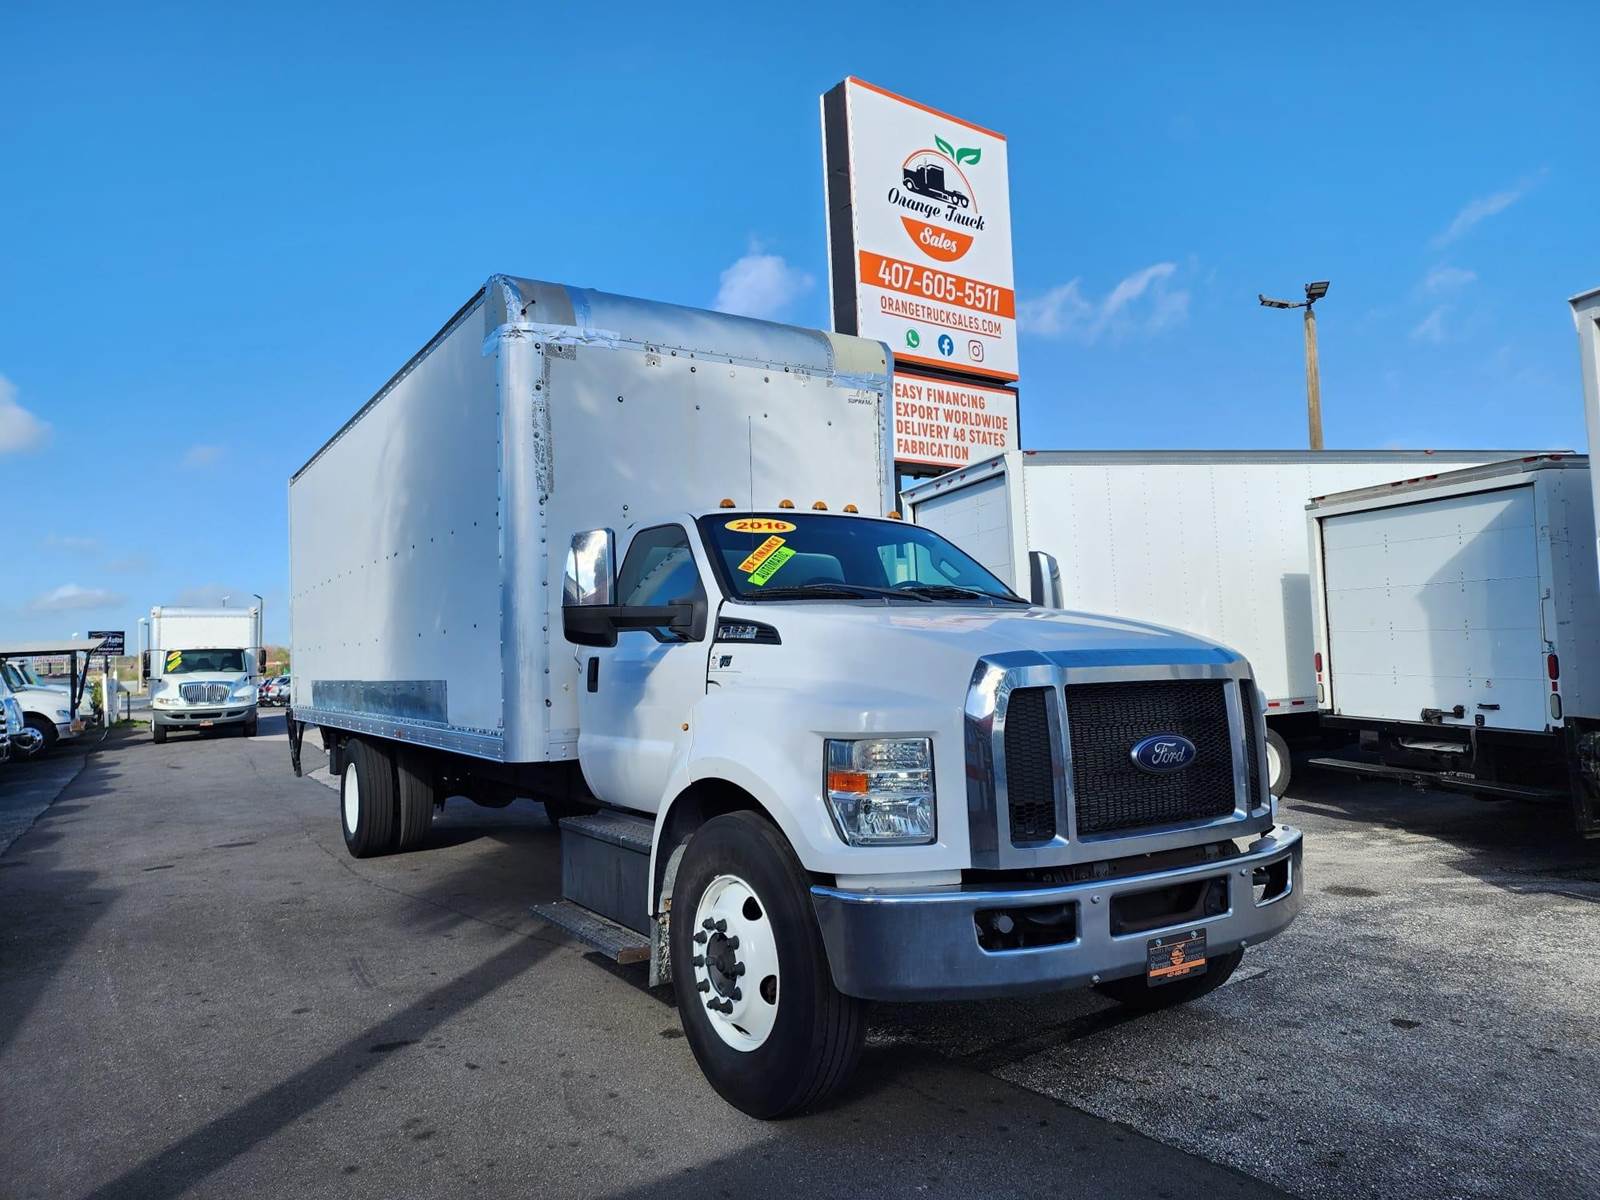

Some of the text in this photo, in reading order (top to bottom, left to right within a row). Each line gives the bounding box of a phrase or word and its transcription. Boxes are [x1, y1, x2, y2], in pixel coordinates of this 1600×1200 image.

[888, 187, 985, 231] Orange Truck
[919, 226, 957, 253] Sales
[878, 259, 1000, 312] 407-605-5511
[880, 295, 1002, 335] ORANGETRUCKSALES.COM
[895, 383, 986, 410] EASY FINANCING
[895, 401, 1008, 431] EXPORT WORLDWIDE
[896, 419, 1006, 448] DELIVERY 48 STATES
[897, 438, 969, 461] FABRICATION
[735, 521, 787, 531] 2016
[755, 551, 790, 580] AUTOMATIC
[1151, 742, 1186, 765] Ford
